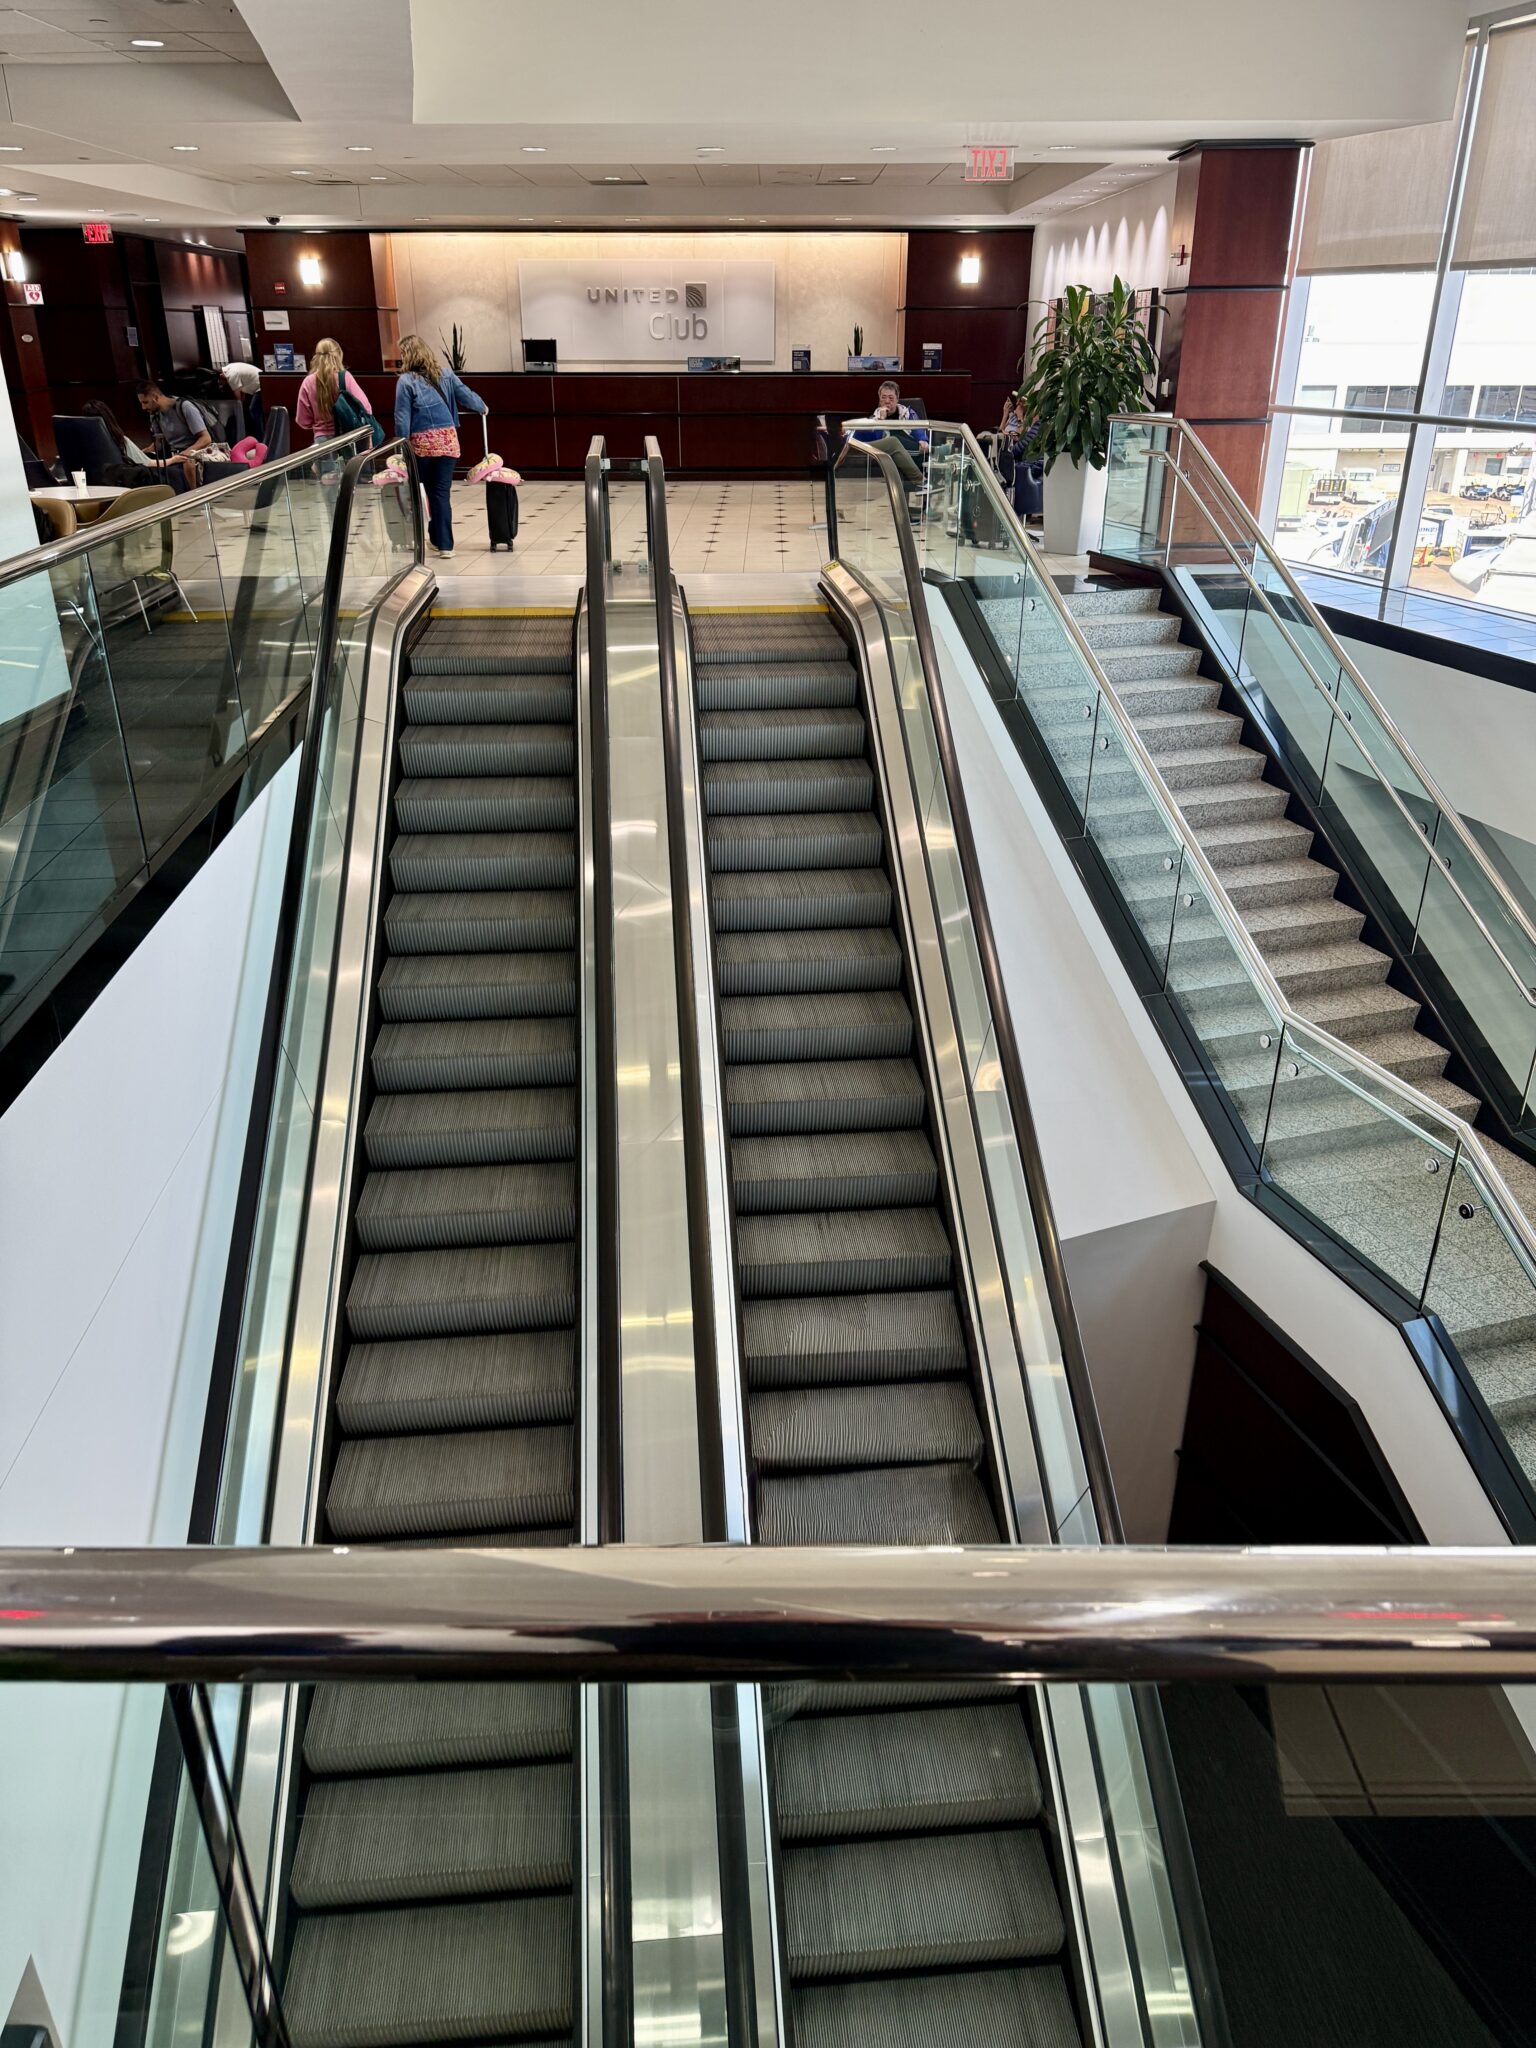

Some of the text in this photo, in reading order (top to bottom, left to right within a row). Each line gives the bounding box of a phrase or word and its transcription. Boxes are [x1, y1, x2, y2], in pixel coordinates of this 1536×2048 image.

[86, 224, 109, 242] EXIT
[587, 287, 679, 304] UNITED
[649, 312, 708, 341] Club
